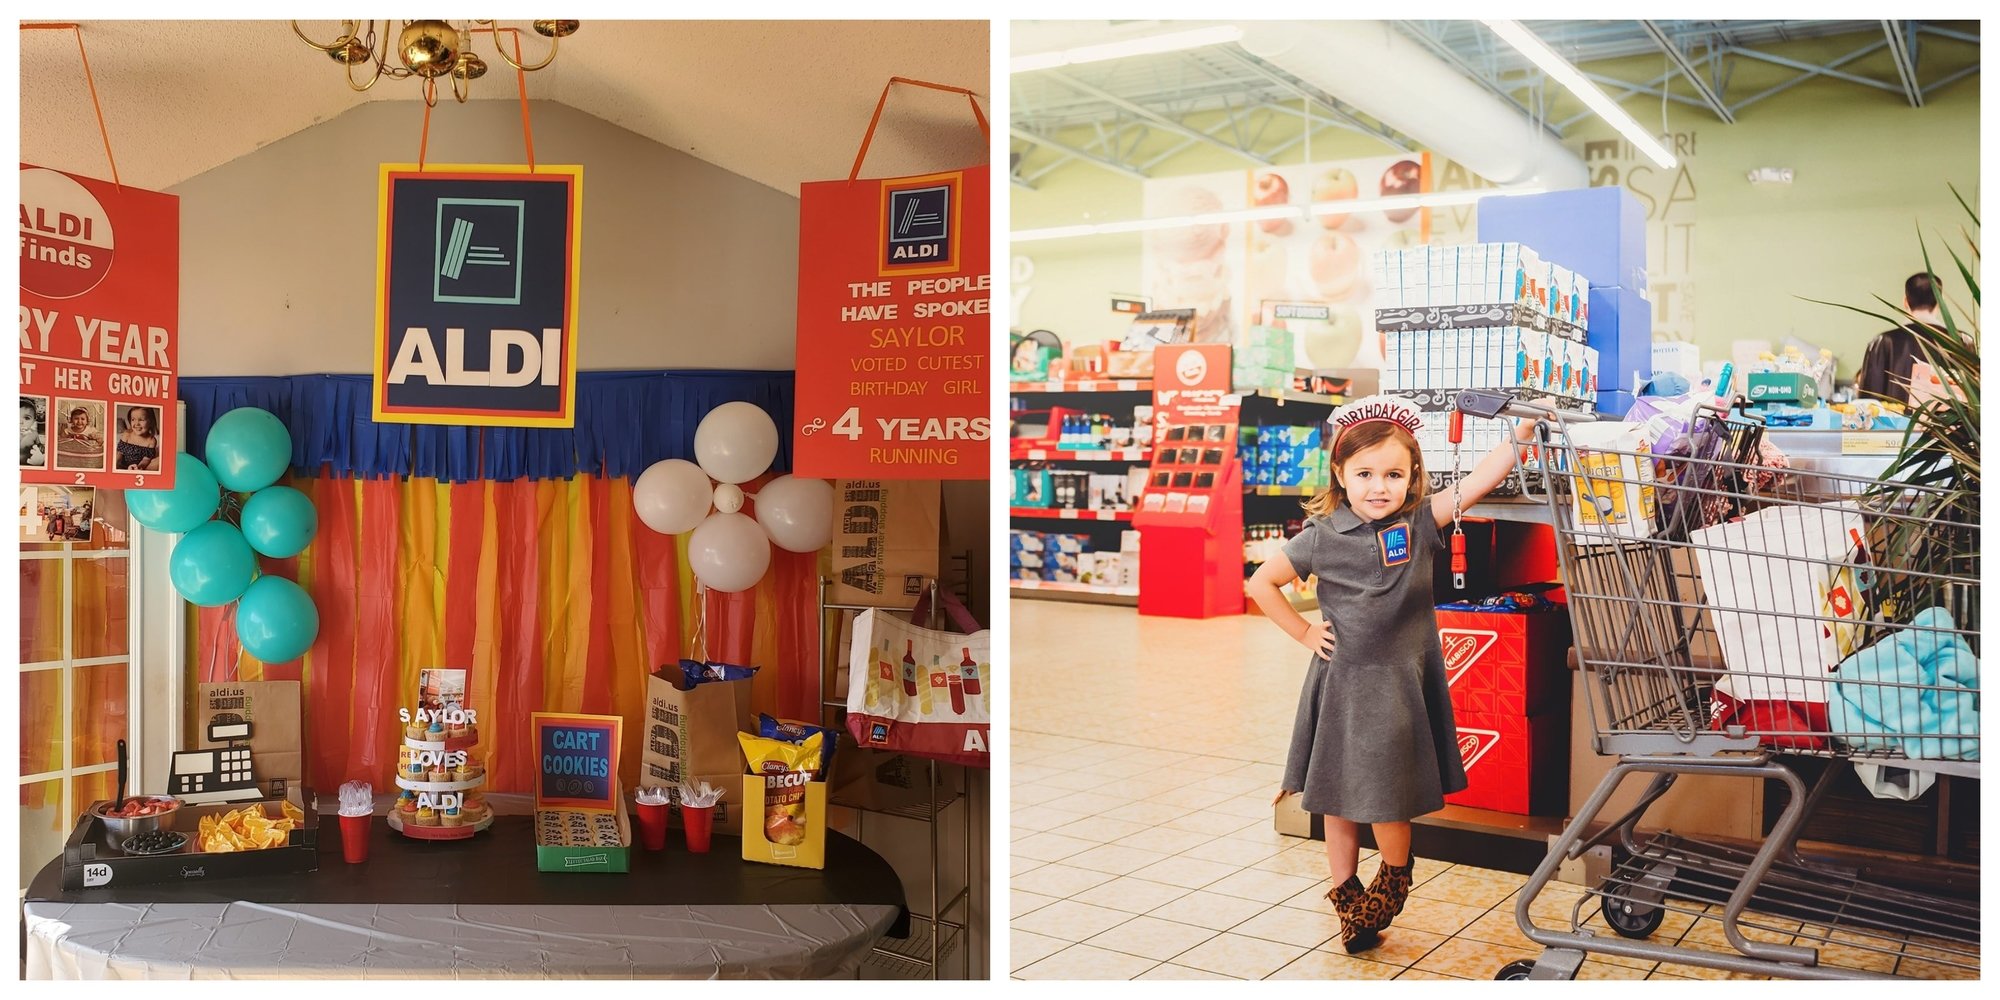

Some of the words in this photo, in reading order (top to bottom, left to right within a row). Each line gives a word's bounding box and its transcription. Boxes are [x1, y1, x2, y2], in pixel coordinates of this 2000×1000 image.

[893, 243, 939, 259] ALDI
[847, 281, 892, 298] THE
[907, 274, 990, 296] PEOPLE
[841, 304, 898, 322] HAVE
[913, 298, 990, 318] SPOKE
[74, 315, 170, 368] YEAR
[869, 325, 965, 348] SAYLOR
[386, 327, 562, 388] ALDI
[850, 357, 907, 372] VOTED
[917, 355, 985, 370] CUTEST
[54, 367, 92, 391] HER
[108, 372, 170, 399] GROW!
[850, 380, 928, 396] BIRTHDAY
[943, 380, 982, 395] GIRL
[831, 407, 863, 441] 4
[876, 417, 990, 441] YEARS
[1336, 403, 1400, 427] BIRTHDAY
[1396, 408, 1425, 434] GIRL
[869, 447, 958, 465] RUNNING
[74, 472, 86, 485] 2
[135, 475, 144, 487] 3
[845, 480, 881, 489] aldi.us
[841, 489, 880, 595] ALDI
[1388, 547, 1407, 558] ALDI
[1446, 639, 1475, 668] NABISCO
[210, 688, 244, 697] aldi.us
[652, 696, 679, 713] aldi.us
[399, 707, 477, 724] SAYLOR
[776, 724, 806, 736] Clancy's
[552, 730, 601, 751] CART
[410, 750, 468, 768] LOVES
[543, 754, 609, 778] COOKIES
[761, 761, 789, 773] Clancy's
[416, 791, 464, 810] ALDI
[86, 867, 107, 877] 14d
